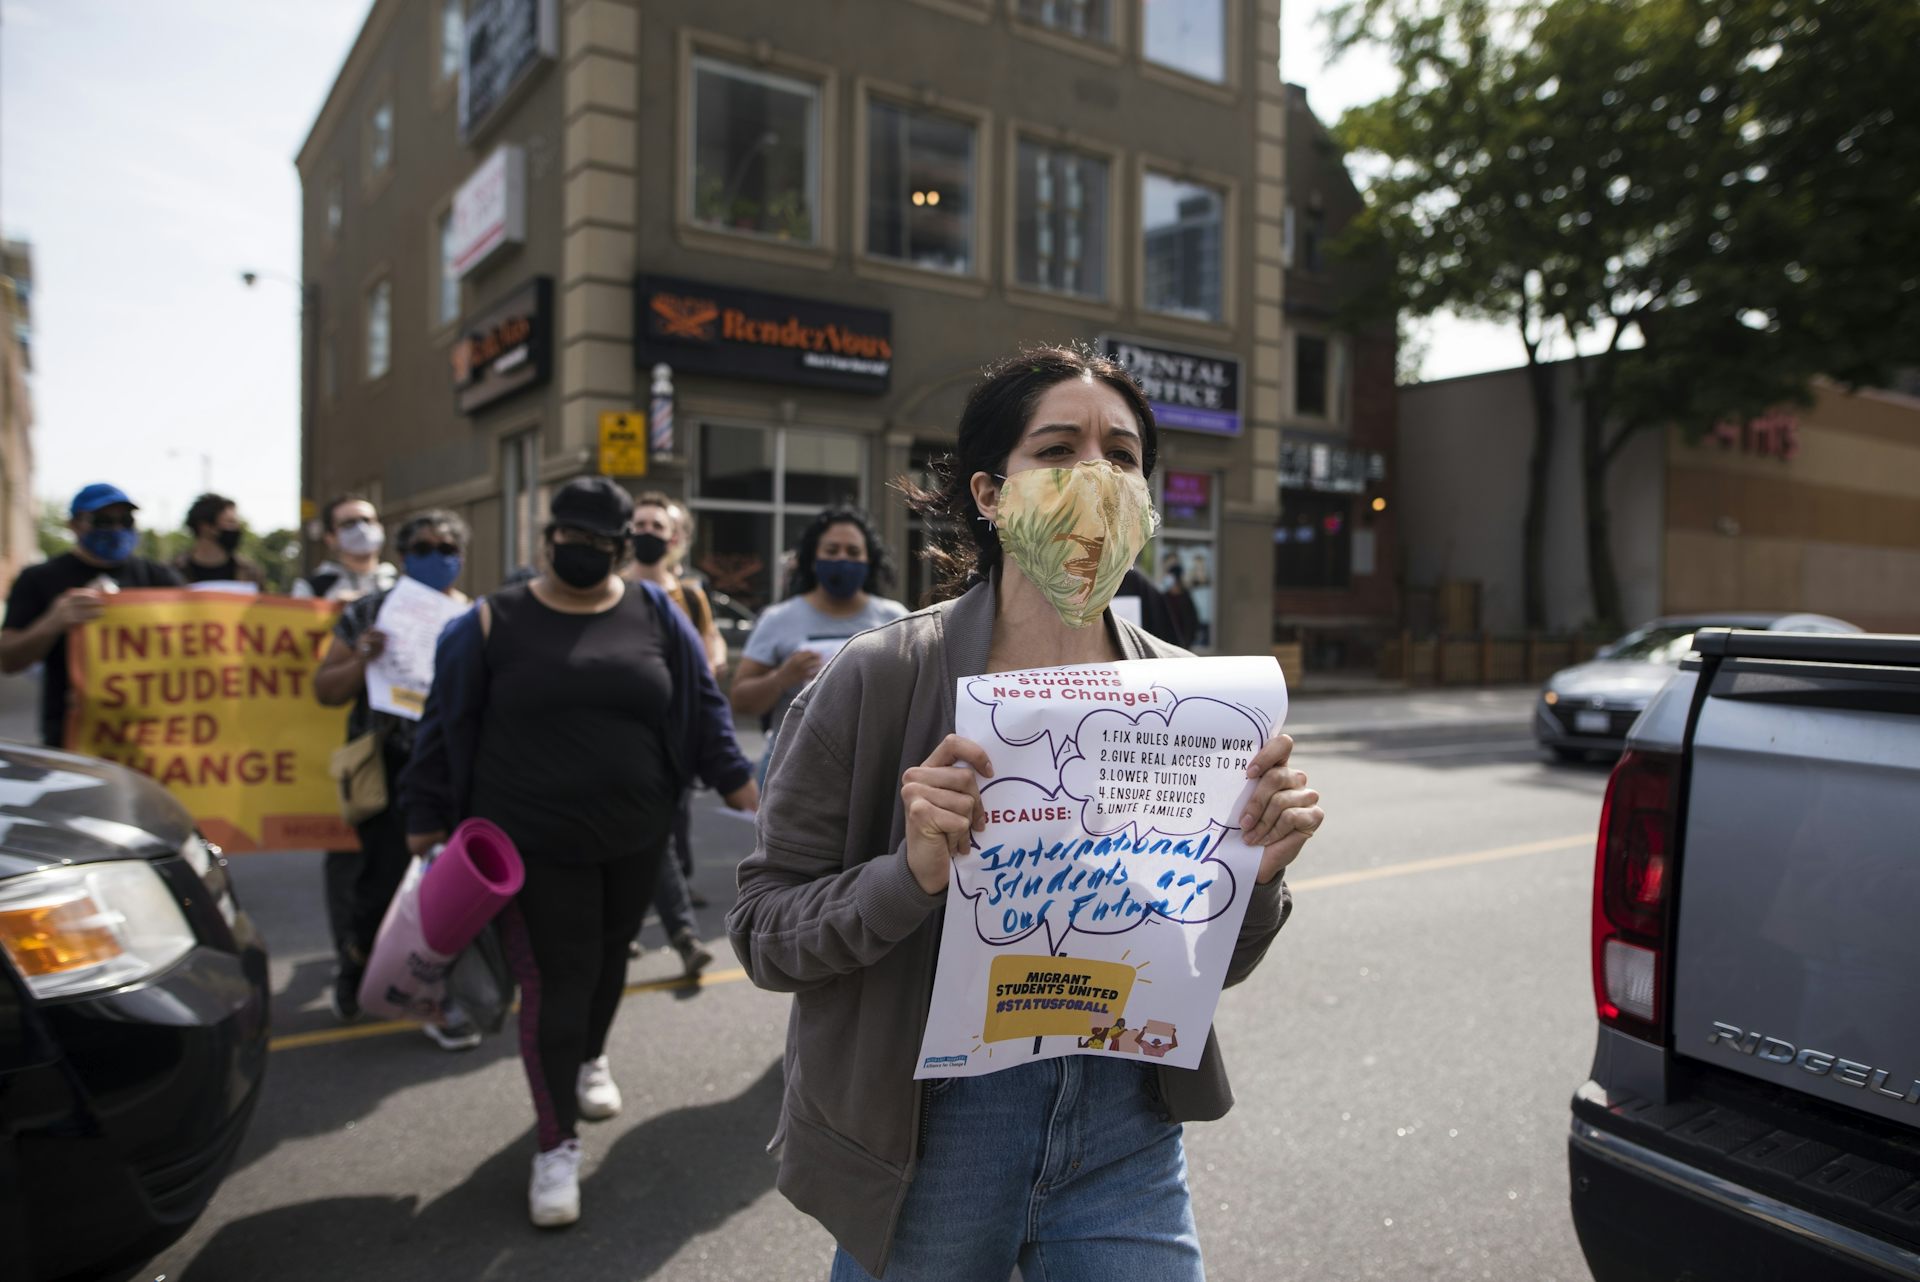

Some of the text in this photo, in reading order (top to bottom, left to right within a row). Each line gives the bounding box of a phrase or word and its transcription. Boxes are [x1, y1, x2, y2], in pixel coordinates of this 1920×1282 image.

[1118, 345, 1230, 388] DENTAL
[1142, 377, 1222, 410] FICE
[1018, 676, 1123, 687] Students
[993, 687, 1158, 707] Need Change!
[94, 713, 219, 747] NEED
[1136, 732, 1169, 746] RULES
[1174, 734, 1217, 749] AROUND
[1222, 738, 1253, 752] WORK
[103, 751, 297, 786] HANGE
[1141, 752, 1166, 766] REAL
[1171, 754, 1211, 768] ACCESS
[1217, 756, 1230, 769] TO
[1234, 758, 1248, 771] PR
[1154, 771, 1197, 786] TUITION
[1156, 789, 1206, 804] SERVICES
[1143, 804, 1193, 819] FAMILIES
[980, 831, 1210, 871] International
[988, 858, 1128, 905] Students
[1025, 971, 1091, 986] MIGRANT
[996, 983, 1119, 1000] STUDENTS UNITED
[996, 998, 1109, 1014] #STATUSFORALL
